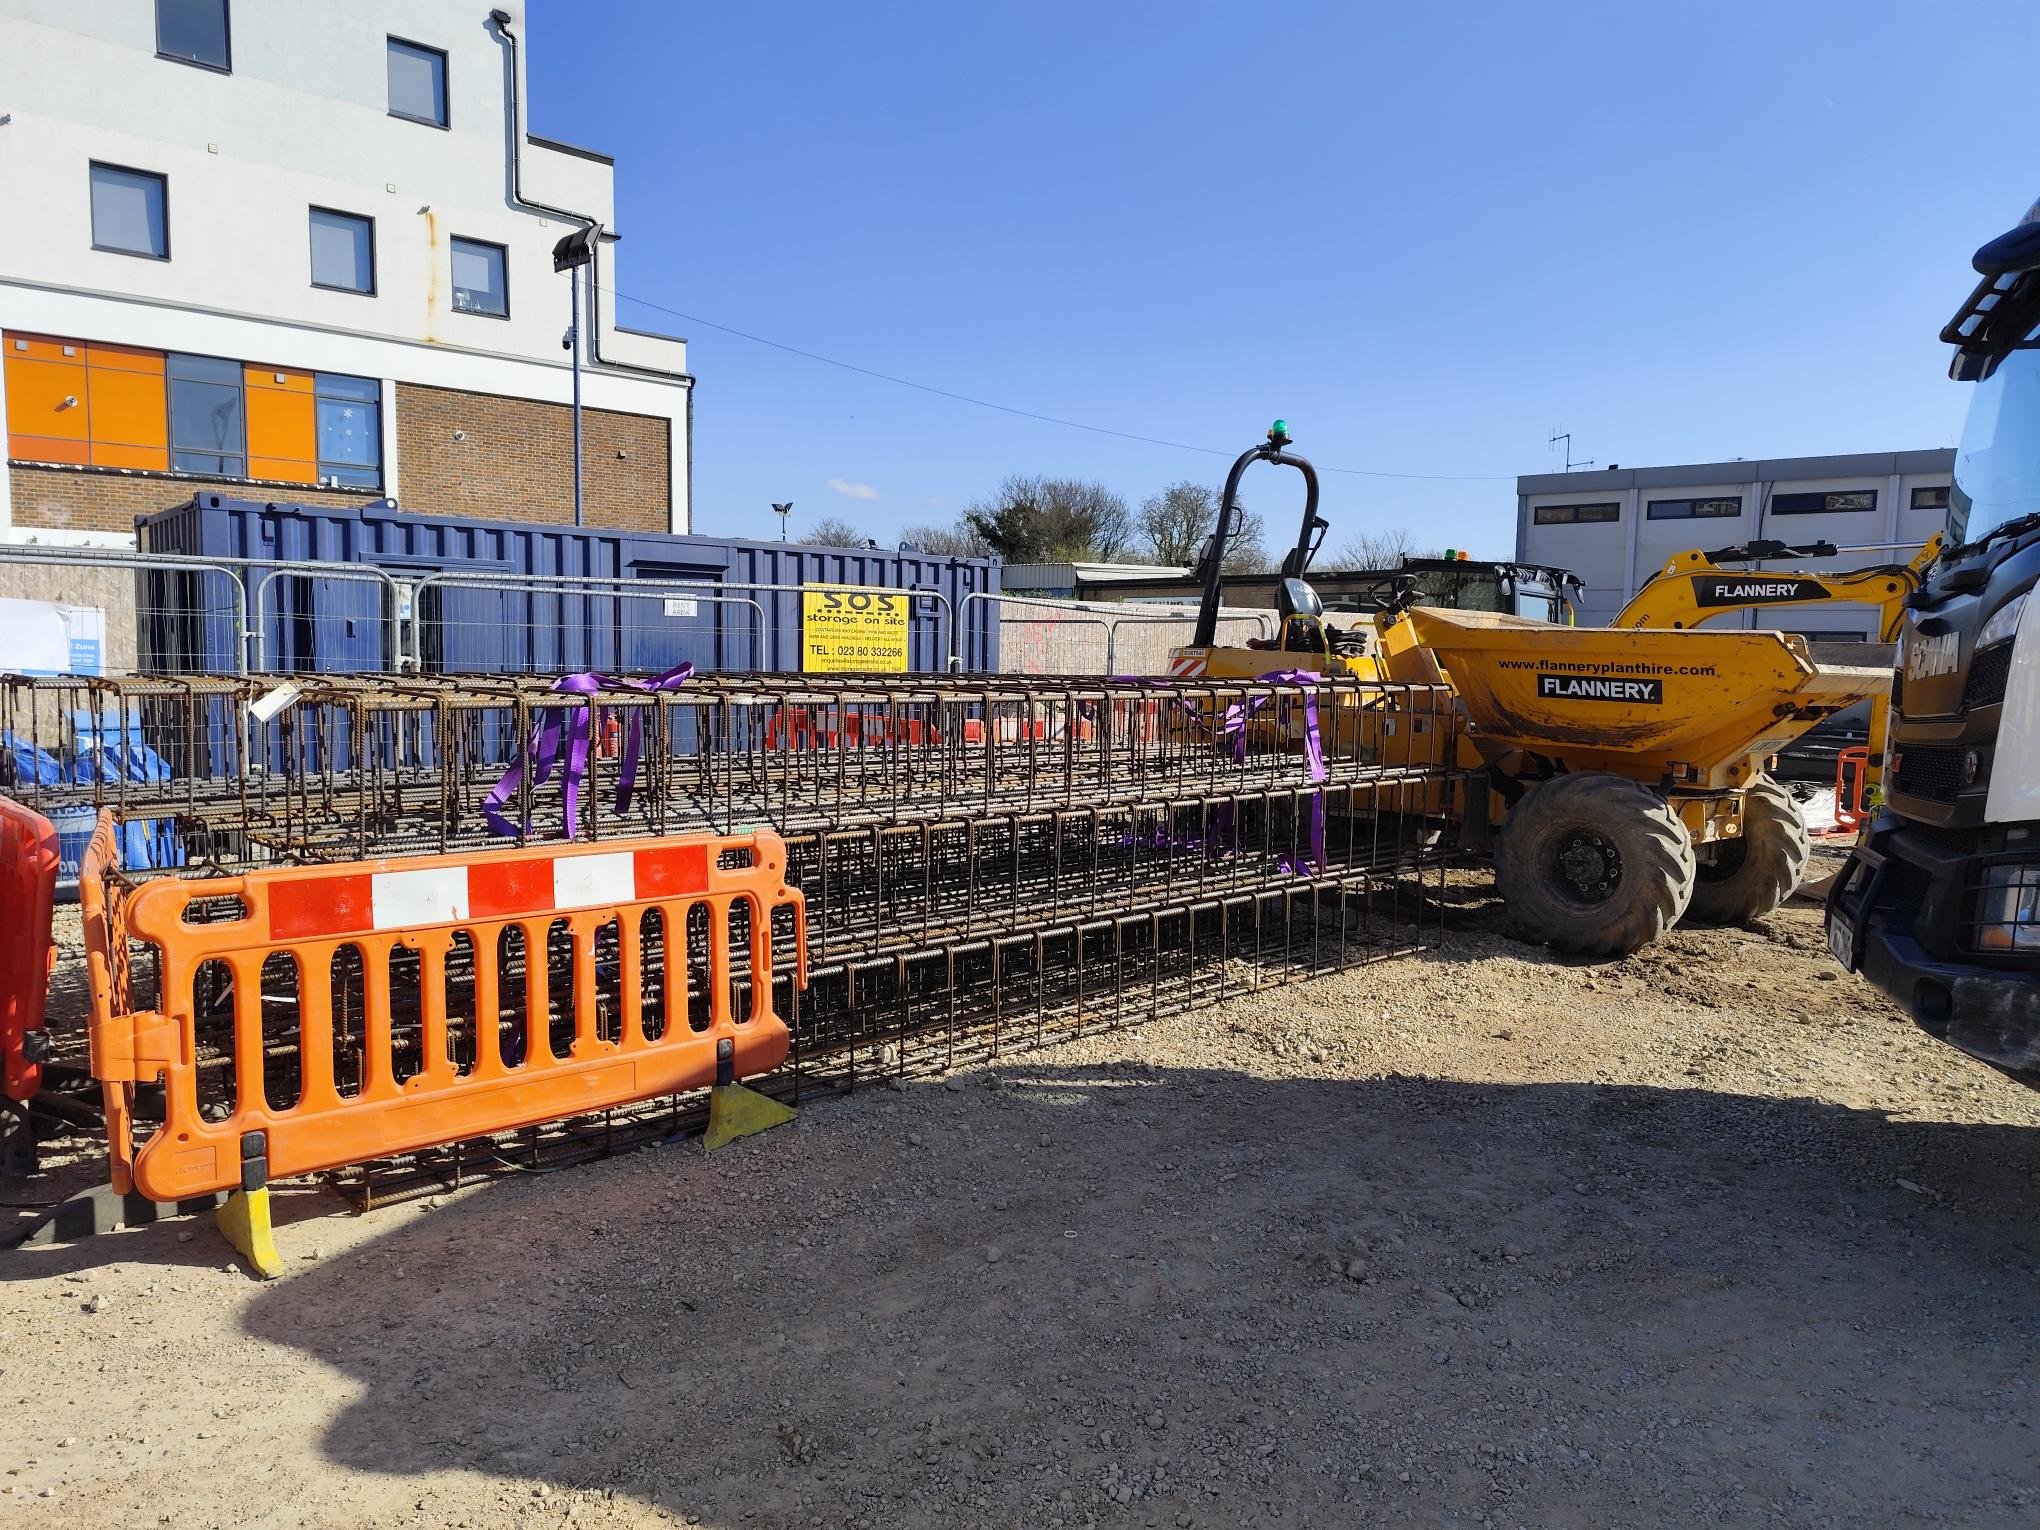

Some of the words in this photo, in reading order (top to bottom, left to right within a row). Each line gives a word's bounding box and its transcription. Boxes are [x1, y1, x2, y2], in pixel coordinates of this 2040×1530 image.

[1715, 583, 1799, 598] FLANNERY
[807, 614, 858, 624] storage
[864, 617, 880, 625] on
[885, 617, 905, 626] site
[838, 645, 854, 656] 023
[857, 646, 868, 656] 80
[871, 647, 903, 657] 332266
[1499, 659, 1716, 676] www.flanneryplanthire.com
[1544, 678, 1655, 700] FLANNERY
